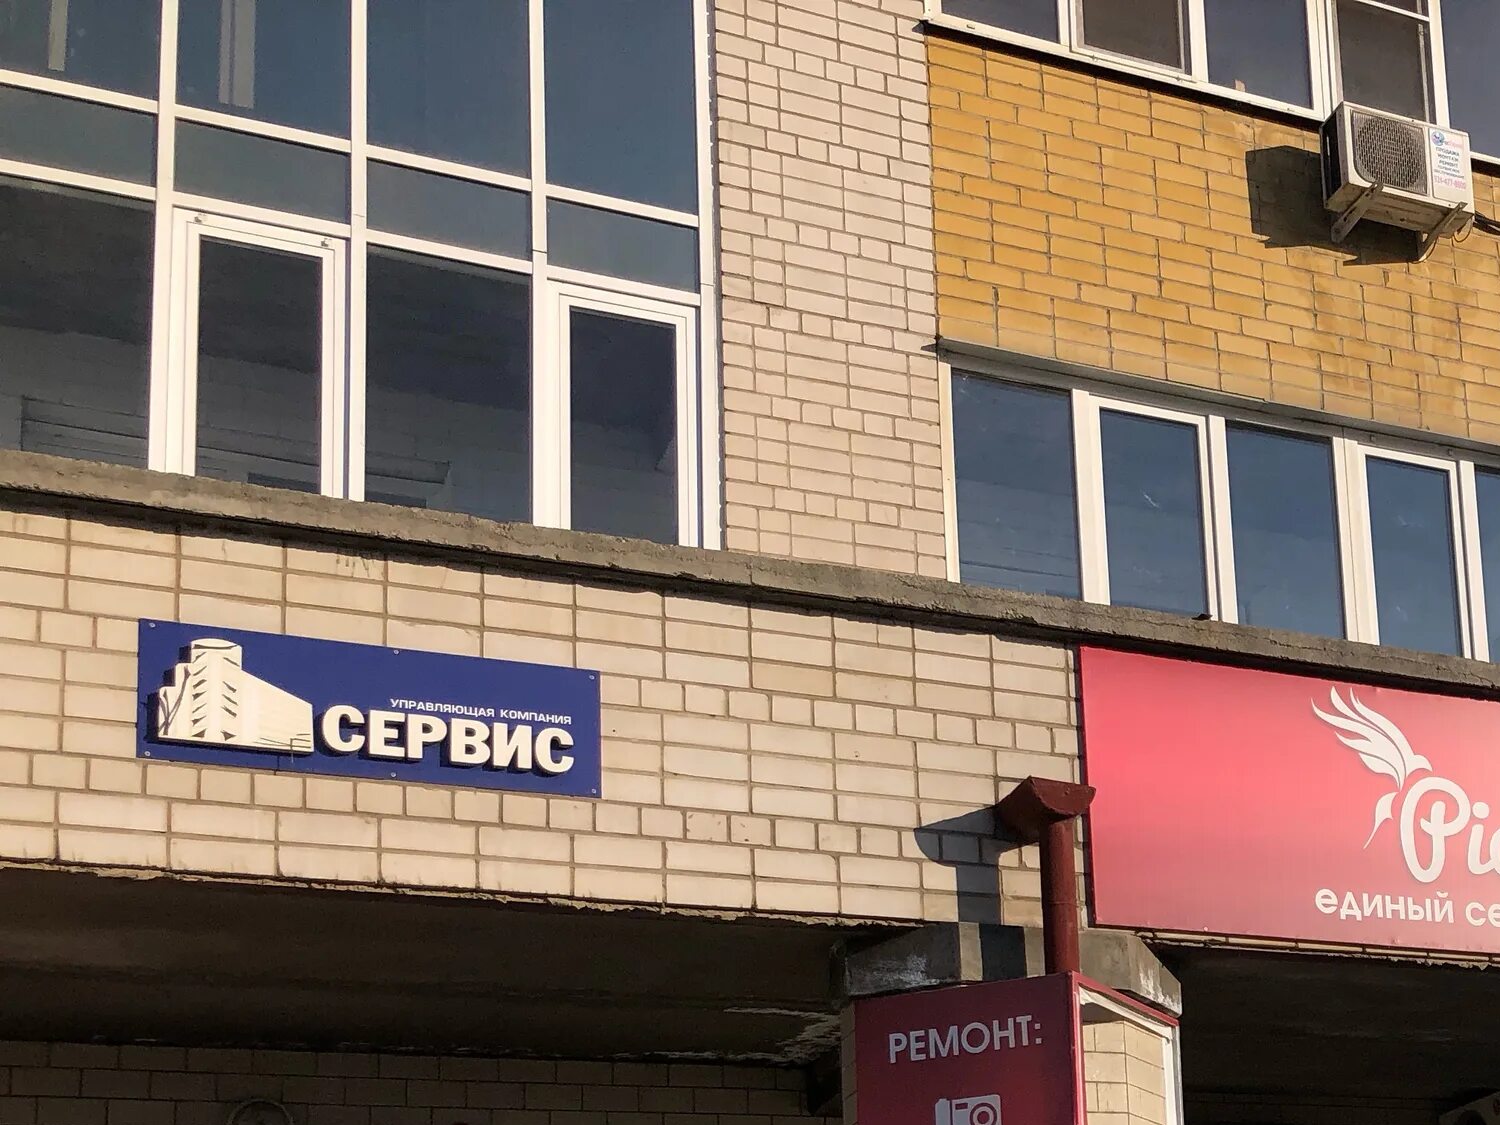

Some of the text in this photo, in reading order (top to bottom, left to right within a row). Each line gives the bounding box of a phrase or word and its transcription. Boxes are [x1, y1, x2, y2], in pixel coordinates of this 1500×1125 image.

[390, 697, 572, 725] УПРАВЛЯЮЩАЯ КОМПАНИЯ
[321, 704, 575, 774] СЕРВИС
[1314, 887, 1455, 925] единый
[888, 1015, 1043, 1064] РЕМОНТ:
